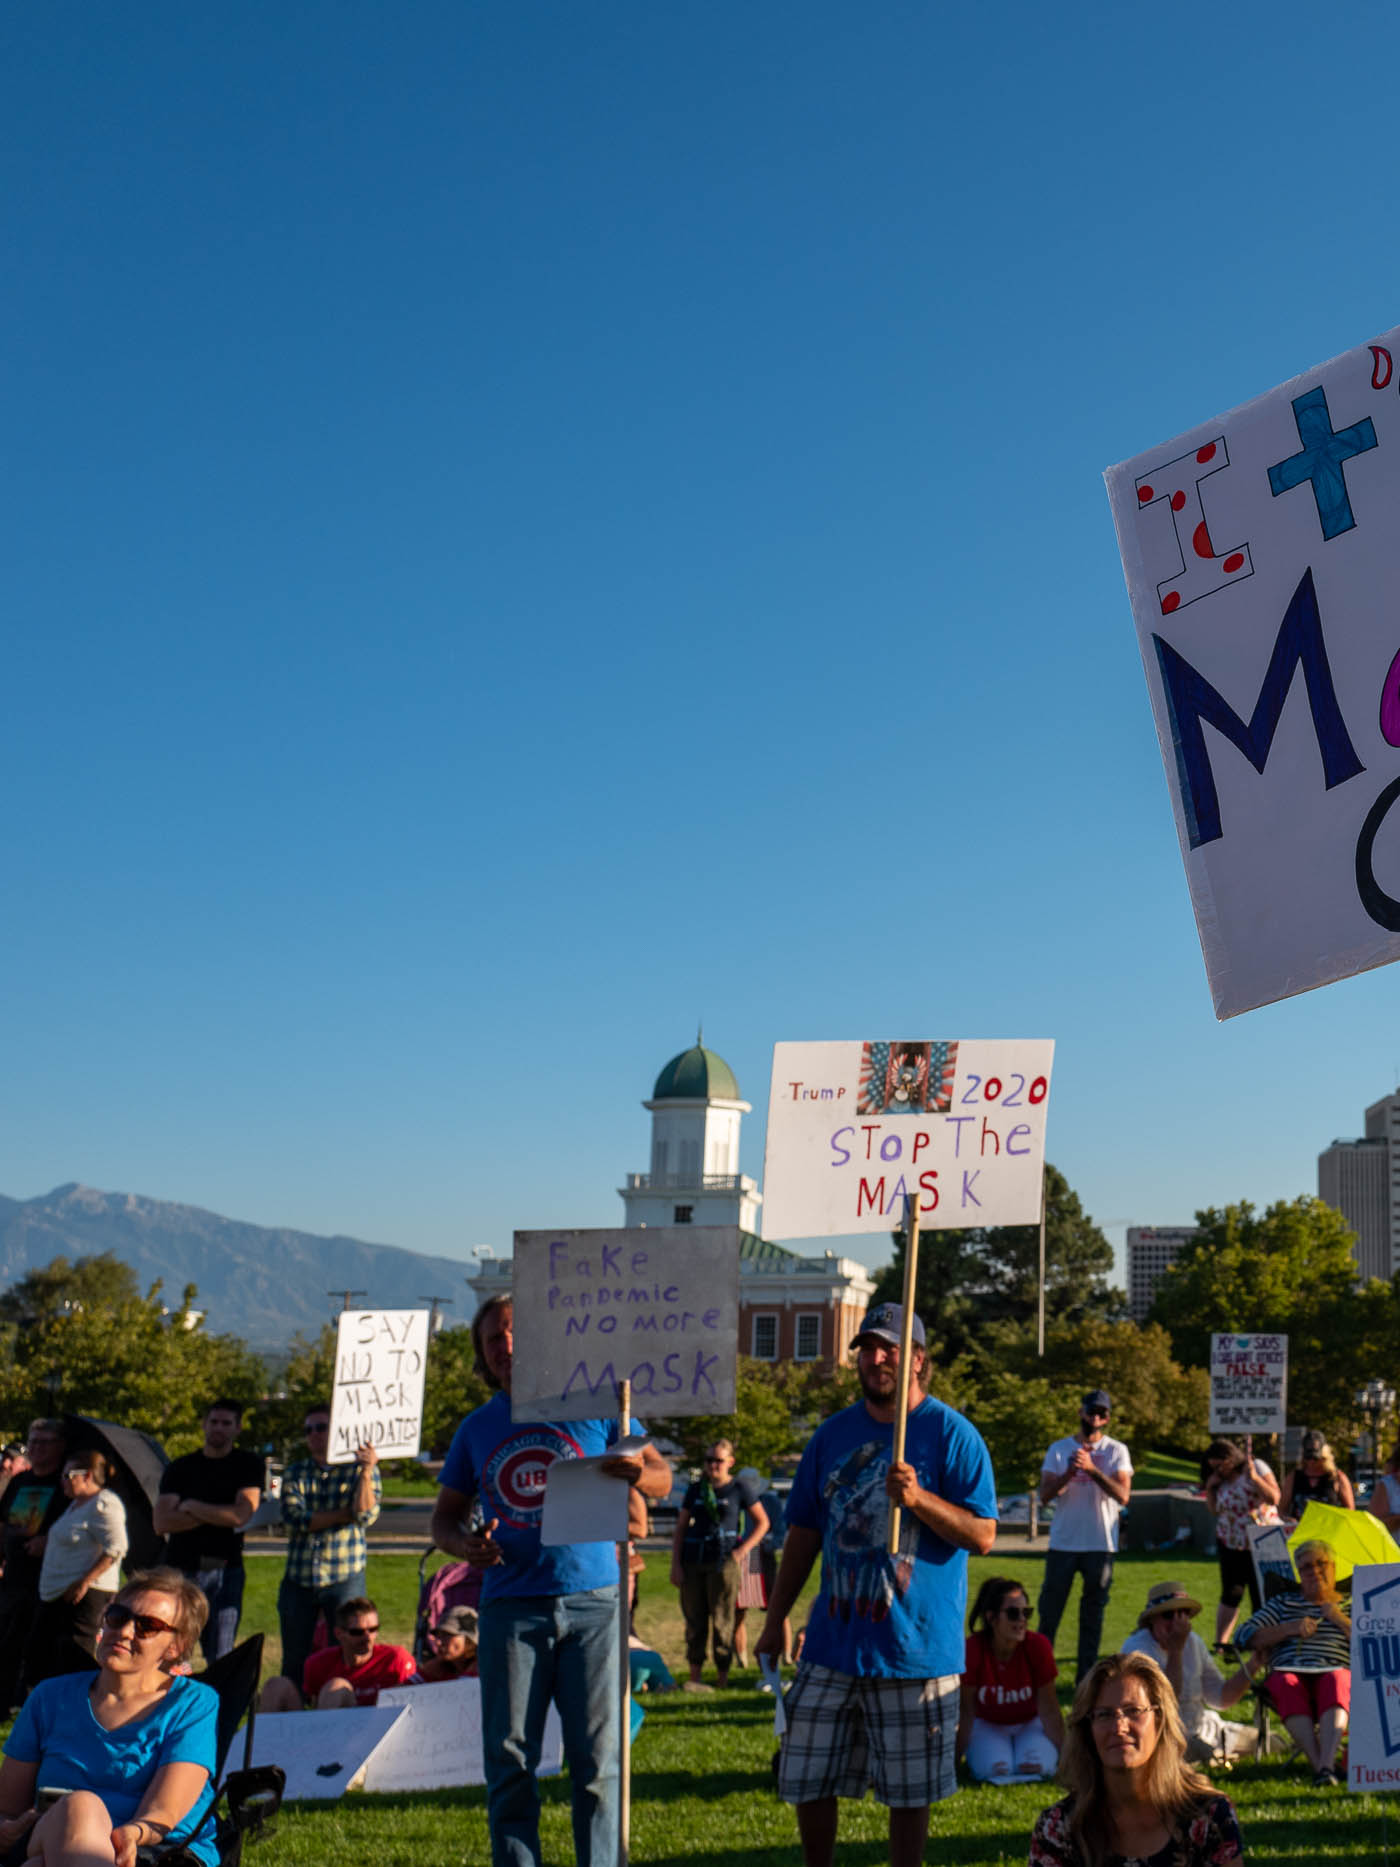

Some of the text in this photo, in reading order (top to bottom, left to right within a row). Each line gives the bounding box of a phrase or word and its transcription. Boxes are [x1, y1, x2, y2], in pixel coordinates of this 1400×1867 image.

[961, 1074, 1048, 1107] 2020
[857, 1170, 982, 1217] MASK
[358, 1315, 415, 1345] SAY
[340, 1349, 421, 1382] NO TO
[339, 1383, 413, 1416] MASK
[336, 1416, 418, 1450] MANDATES
[1356, 1614, 1395, 1634] Greg
[979, 1686, 1033, 1705] Ciao
